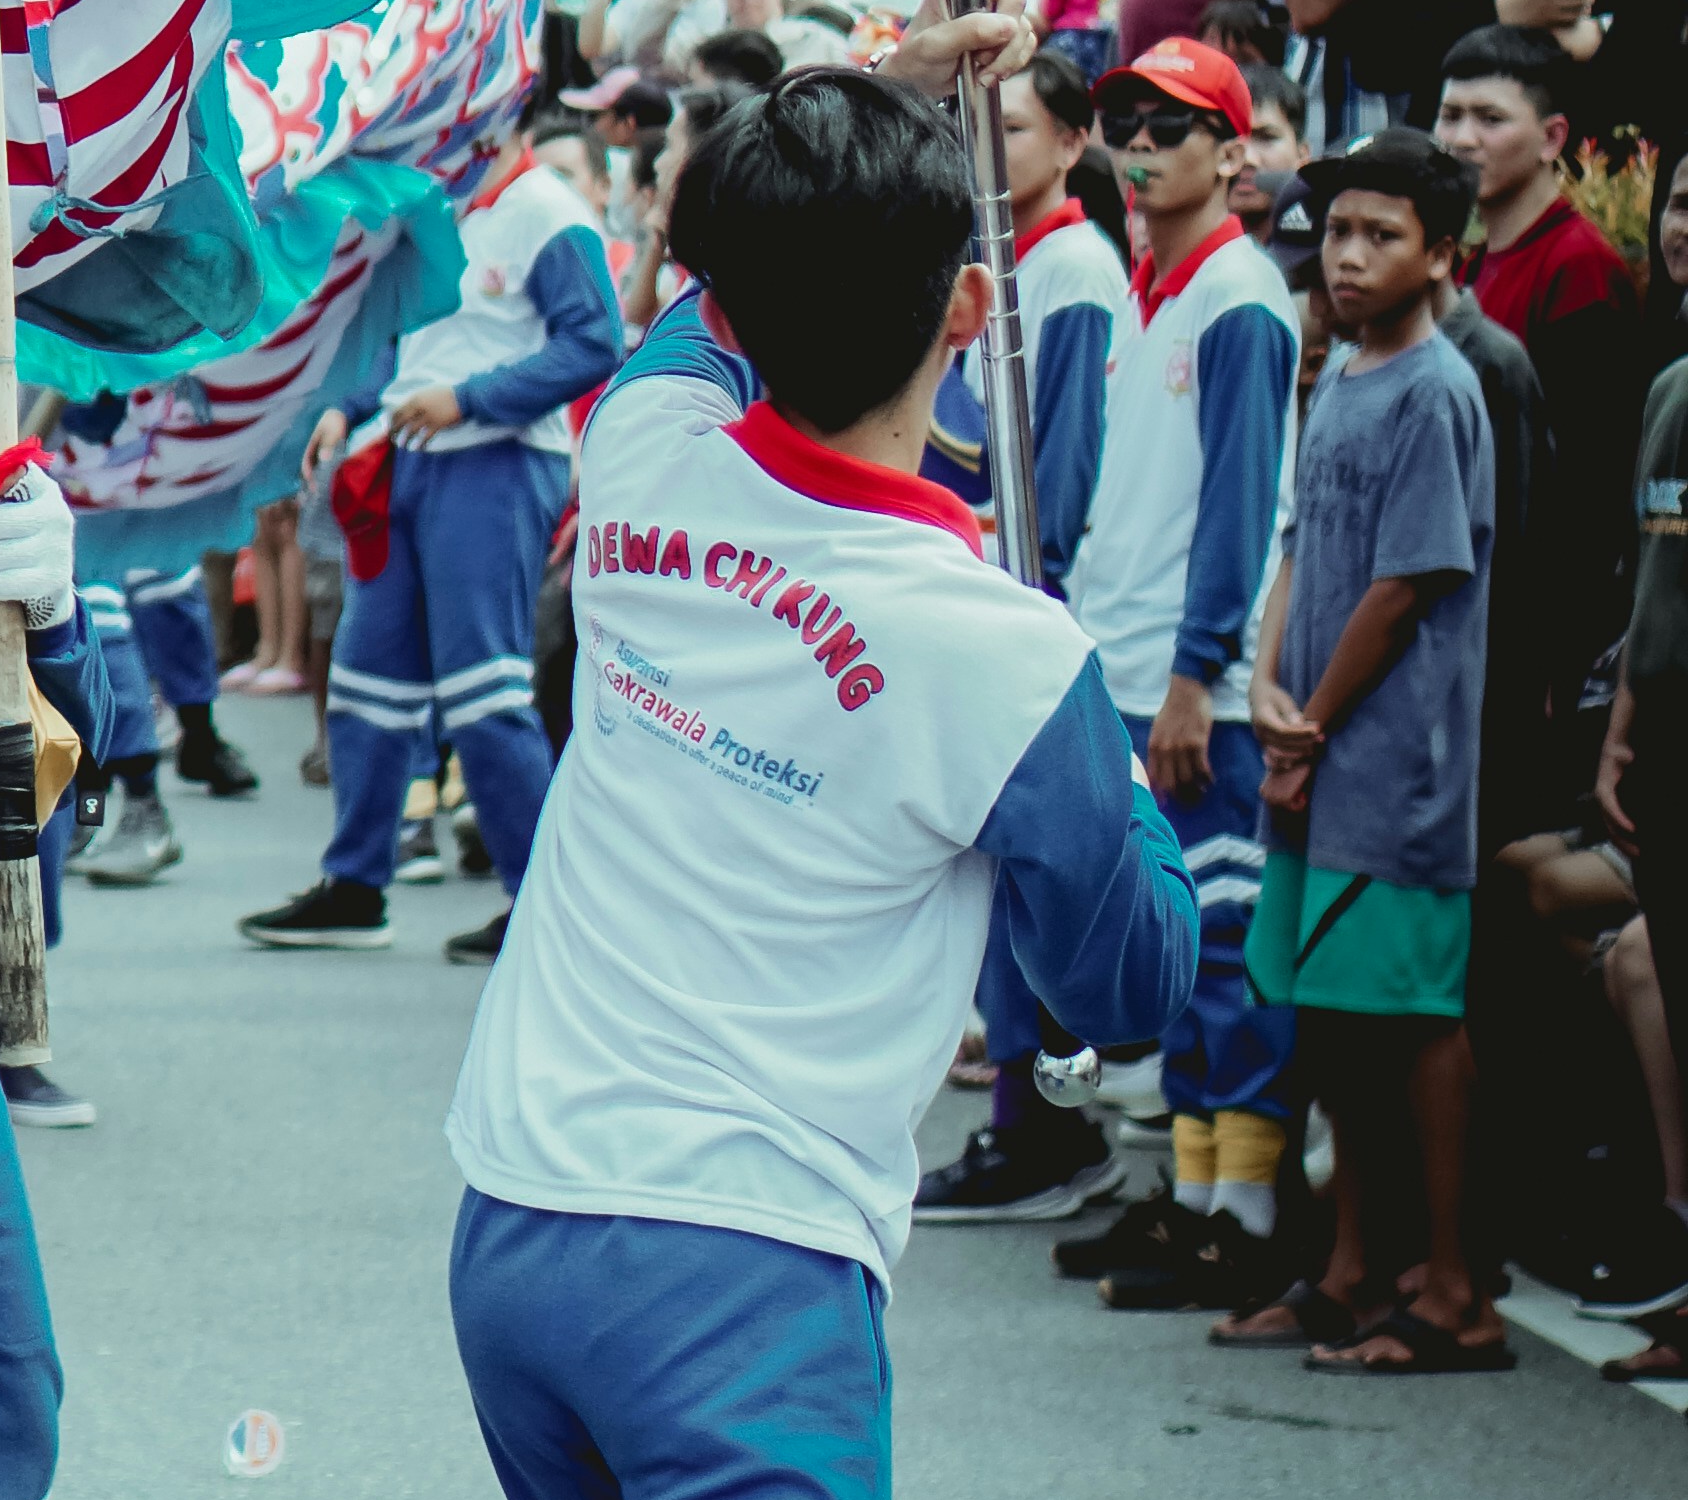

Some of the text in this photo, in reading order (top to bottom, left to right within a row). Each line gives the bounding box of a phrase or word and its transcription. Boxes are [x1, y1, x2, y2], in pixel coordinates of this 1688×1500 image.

[587, 521, 885, 712] DEWA CHI KUNG
[604, 661, 824, 797] Cakrawala Proteksi
